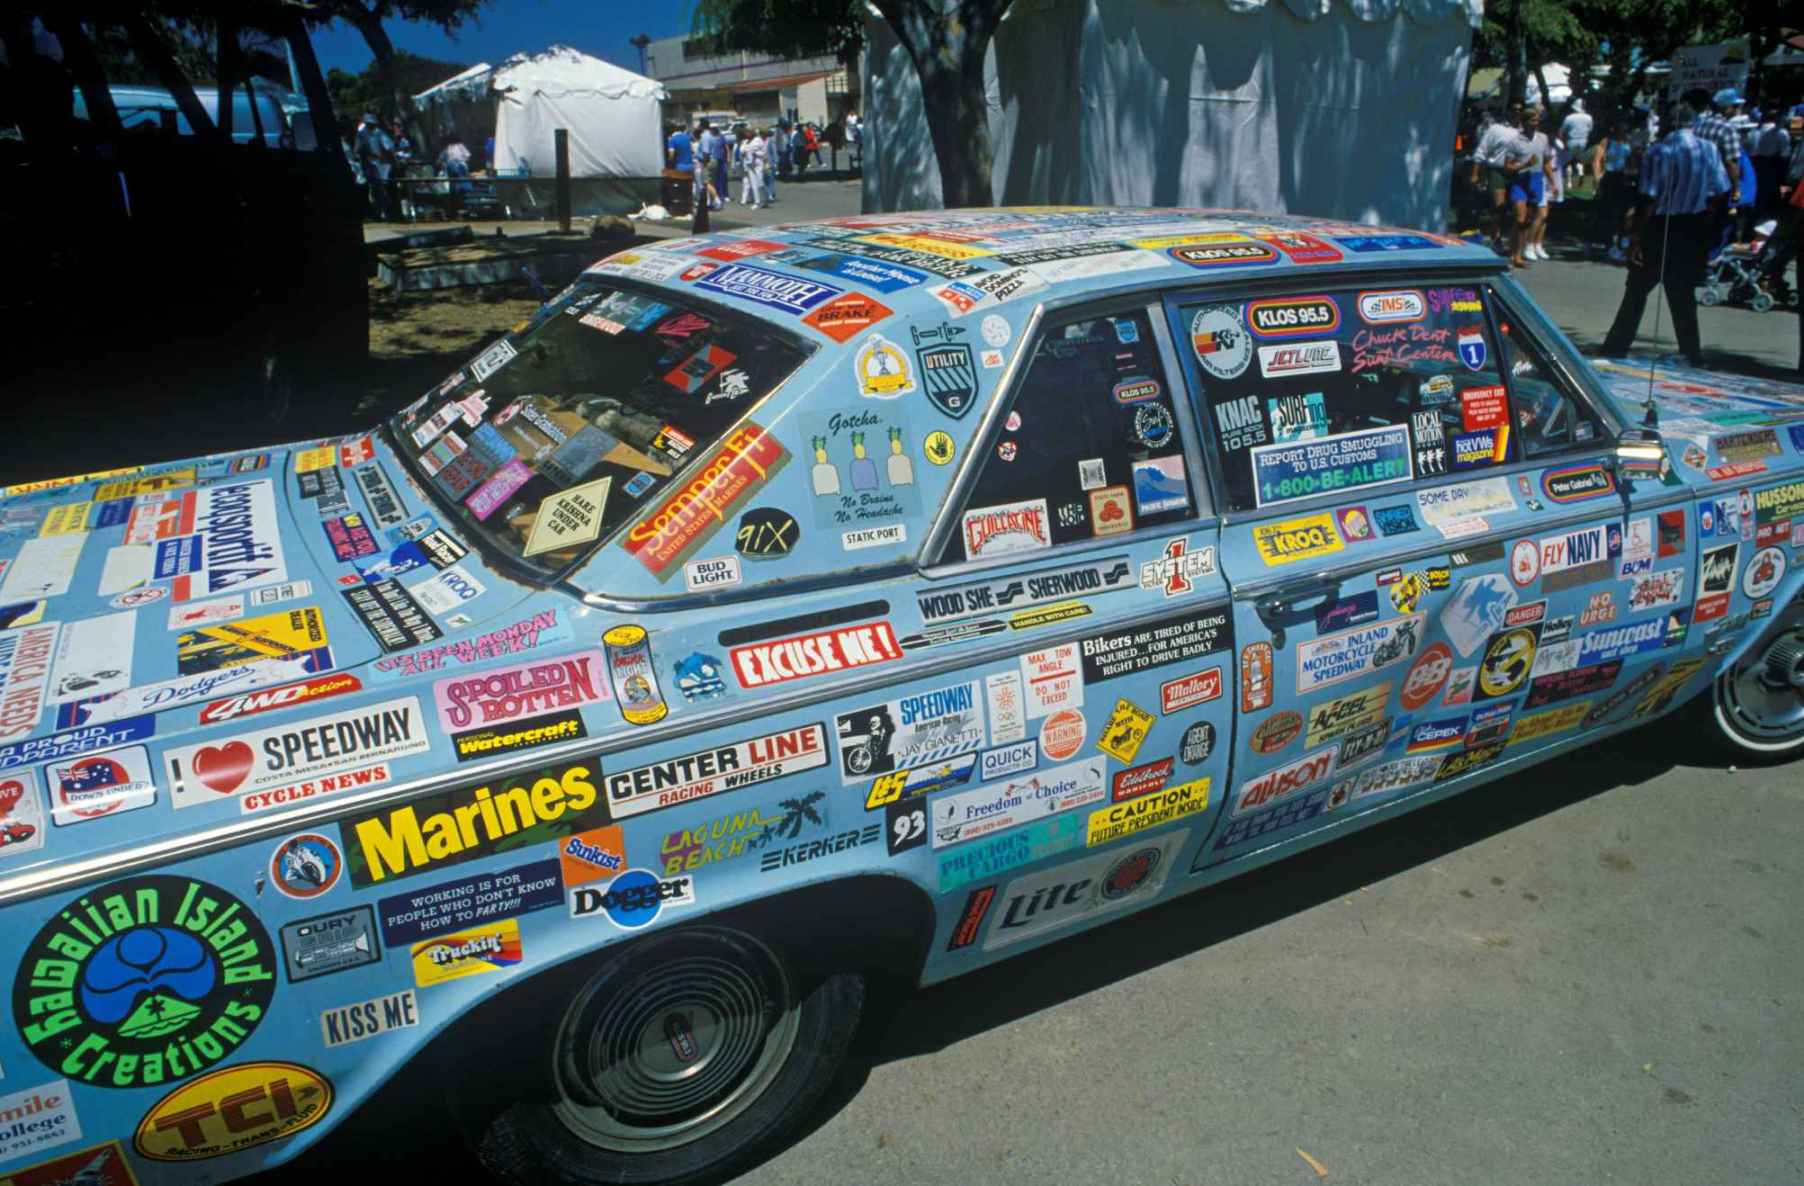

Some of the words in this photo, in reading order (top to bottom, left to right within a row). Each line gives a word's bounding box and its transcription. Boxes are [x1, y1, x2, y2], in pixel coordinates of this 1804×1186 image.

[710, 266, 826, 308] MAMMOTH
[817, 306, 876, 321] BRAKE
[1258, 309, 1297, 327] KLOS
[1298, 306, 1329, 323] 95.5
[926, 352, 966, 369] UTILITY
[1468, 345, 1479, 364] 1
[948, 396, 961, 407] G
[1215, 395, 1262, 432] KNAC
[829, 409, 881, 437] Gotcha
[1222, 432, 1266, 452] 105.5
[1261, 449, 1303, 466] REPORT
[1307, 445, 1338, 460] DRUG
[1341, 432, 1402, 454] SMUGGLING
[1293, 460, 1307, 472] TO
[1311, 457, 1328, 470] U.S.
[1330, 449, 1377, 465] CUSTOMS
[630, 453, 738, 546] Semper
[724, 428, 767, 480] Fi
[1263, 458, 1405, 500] 1-800-BE-ALERT
[556, 499, 592, 527] KRISHNA
[571, 494, 597, 512] HARE
[834, 511, 852, 523] No
[852, 506, 903, 520] Headache
[840, 497, 858, 509] No
[1419, 490, 1449, 506] SOME
[547, 521, 565, 536] CAR
[552, 508, 580, 532] UNDER
[736, 519, 794, 553] 91X
[847, 530, 873, 545] STATIC
[876, 527, 899, 540] PORT
[1276, 527, 1325, 554] KROQ
[1543, 542, 1567, 567] FLY
[1567, 529, 1602, 566] NAVY
[439, 570, 477, 600] KROQ
[693, 570, 732, 585] LIGHT
[697, 561, 726, 575] BUD
[1140, 549, 1216, 588] SYSTEM
[919, 593, 965, 620] WOOD
[965, 587, 995, 611] SHE
[1028, 569, 1101, 599] SHERWOOD
[475, 609, 558, 651] MONDAY
[1506, 604, 1543, 624] DANGER
[455, 629, 540, 665] WEEK!
[1083, 635, 1133, 657] Bikers
[1134, 633, 1151, 645] ARE
[1153, 627, 1182, 641] TIRED
[1183, 623, 1195, 634] OF
[1197, 615, 1226, 632] BEING
[1148, 640, 1168, 654] FOR
[1169, 629, 1218, 650] AMERICA'S
[1347, 627, 1388, 646] INLAND
[10, 626, 57, 685] AMERICA
[736, 636, 842, 686] EXCUSE
[1028, 652, 1046, 665] MAX
[1056, 647, 1073, 658] TOW
[1039, 661, 1063, 673] ANGLE
[1103, 660, 1133, 677] RIGHT
[1136, 656, 1149, 669] TO
[1152, 650, 1182, 665] DRIVE
[1182, 641, 1213, 658] BADLY
[1304, 643, 1378, 672] MOTORCYCLE
[1313, 659, 1367, 683] SPEEDWAY
[143, 665, 257, 709] Dodgers
[446, 661, 566, 728] SPOILED
[478, 656, 598, 723] ROTTEN
[1054, 680, 1072, 692] NOT
[1166, 675, 1218, 701] Mallory
[900, 685, 974, 726] SPEEDWAY
[24, 727, 106, 752] PROUD
[171, 758, 184, 793] I
[264, 706, 410, 772] SPEEDWAY
[460, 720, 579, 754] Watercraft
[1417, 726, 1460, 742] CEPEK
[611, 746, 740, 800] CENTER
[748, 726, 819, 766] LINE
[985, 746, 1032, 769] QUICK
[245, 781, 316, 811] CYCLE
[321, 766, 388, 791] NEWS
[658, 782, 713, 807] RACING
[725, 764, 783, 789] WHEELS
[966, 794, 1023, 819] Freedom
[1035, 778, 1078, 800] Choice
[1090, 820, 1127, 844] FUTURE
[1128, 806, 1176, 832] PRESIDENT
[1176, 798, 1203, 815] INSIDE
[1109, 786, 1193, 823] CAUTION
[355, 766, 598, 882] Marines
[661, 808, 766, 855] LAGUNA
[893, 811, 925, 848] 93
[564, 836, 623, 872] Sunkist
[663, 834, 750, 877] BEACH
[780, 830, 862, 868] KERKER
[387, 906, 438, 927] PEOPLE
[439, 897, 472, 916] WHO
[474, 886, 515, 907] DON'T
[517, 877, 557, 896] KNOW
[411, 883, 475, 909] WORKING
[478, 879, 493, 892] IS
[495, 874, 521, 888] FOR
[573, 876, 690, 917] Dogger
[1001, 878, 1092, 929] Lite
[420, 916, 453, 931] HOW
[454, 908, 475, 922] TO
[22, 888, 160, 1046] Hawaiian
[173, 881, 274, 985] Island
[325, 1003, 379, 1045] KISS
[383, 992, 416, 1029] ME
[60, 999, 263, 1086] Creations
[154, 1077, 298, 1149] TCI
